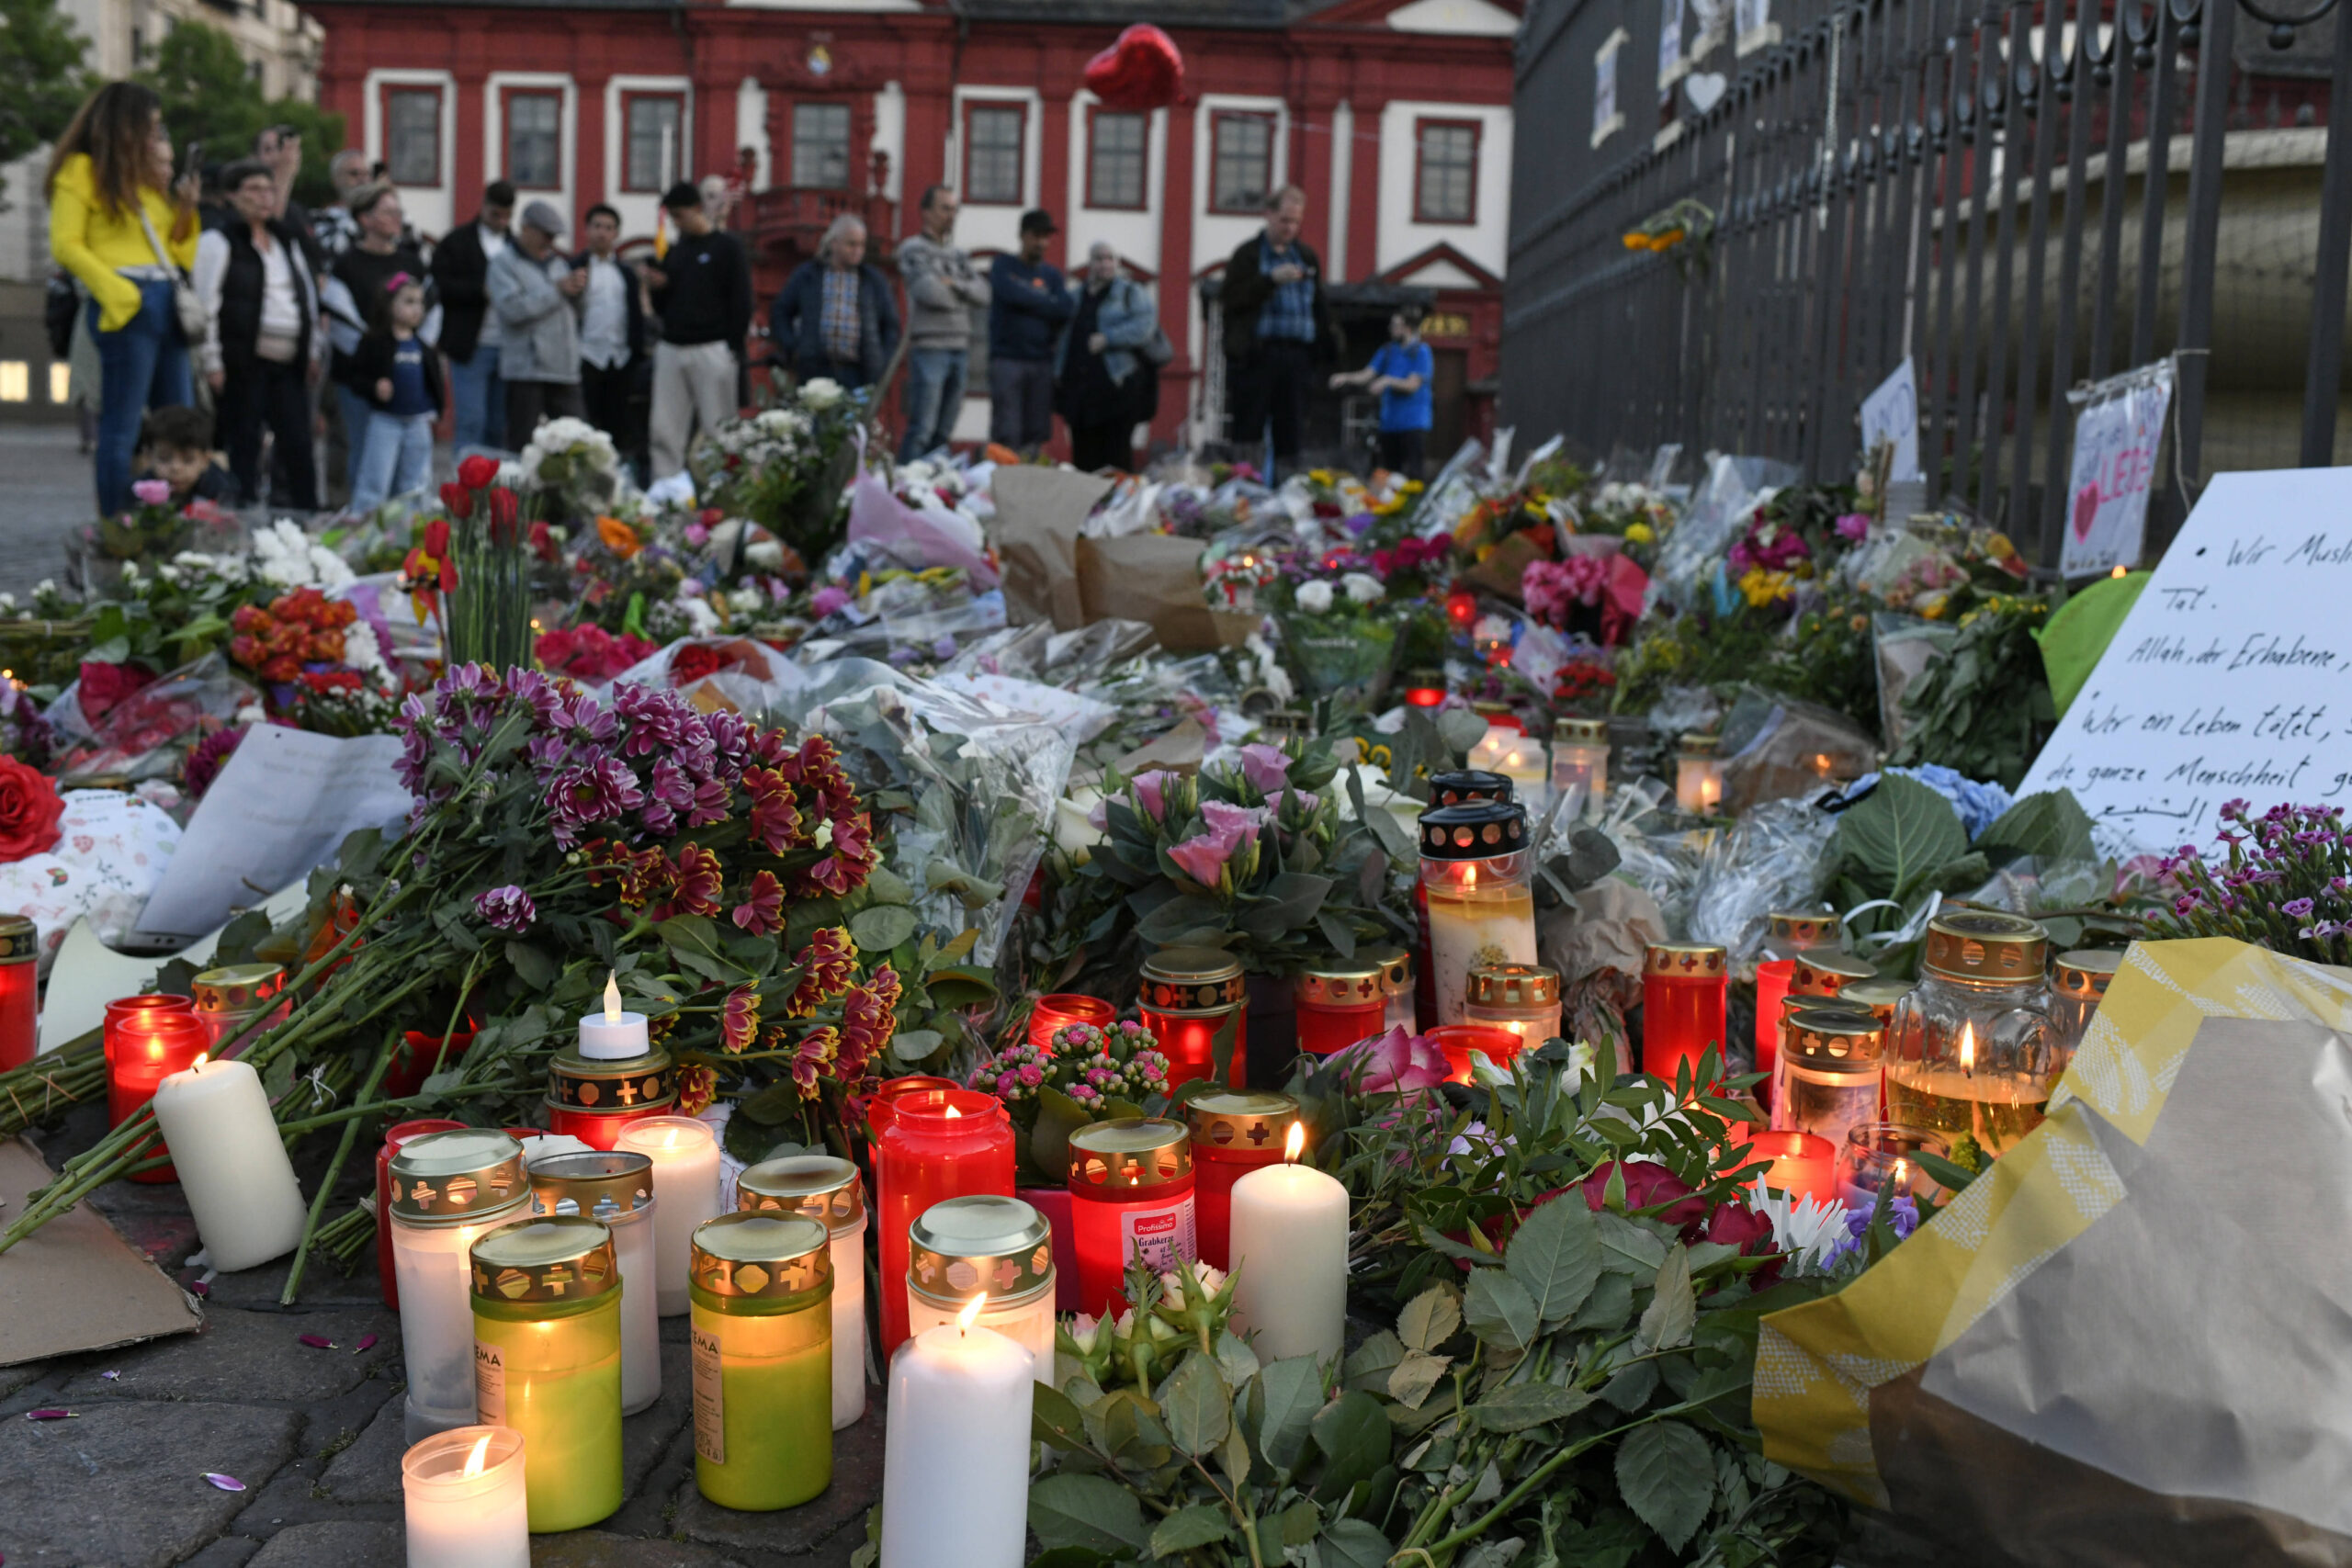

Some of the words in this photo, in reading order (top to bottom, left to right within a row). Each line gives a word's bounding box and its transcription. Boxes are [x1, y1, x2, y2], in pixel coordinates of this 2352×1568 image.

[2226, 535, 2276, 567] Wir
[2127, 635, 2194, 664] Allah,
[2196, 637, 2229, 664] der
[2226, 632, 2350, 672] Erhabene,
[2178, 706, 2241, 735] Leben
[2253, 704, 2331, 743] tötet,
[2047, 753, 2075, 782] die
[2077, 765, 2146, 793] ganze
[2164, 754, 2312, 789] Menschheit
[1137, 1222, 1173, 1232] Profissimo
